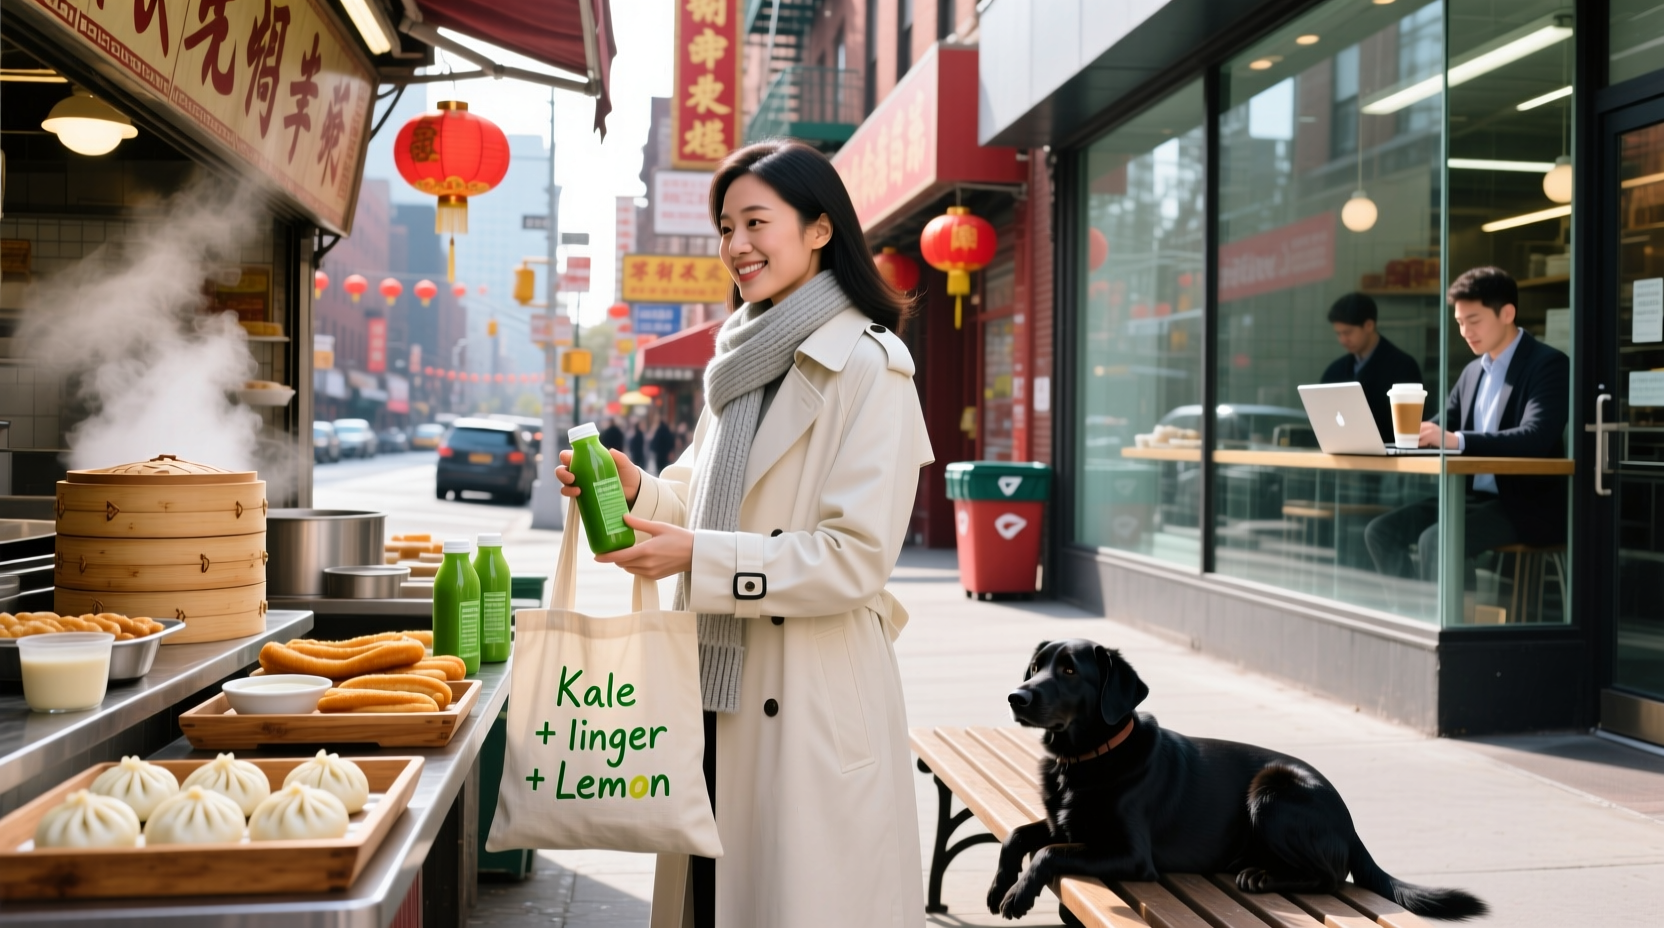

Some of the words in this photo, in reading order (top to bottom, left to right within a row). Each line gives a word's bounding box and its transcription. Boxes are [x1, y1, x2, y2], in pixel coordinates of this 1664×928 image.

[556, 665, 637, 708] Kale
[535, 721, 556, 745] +
[569, 718, 668, 768] linger
[525, 768, 545, 791] +
[556, 760, 670, 800] Lemon
